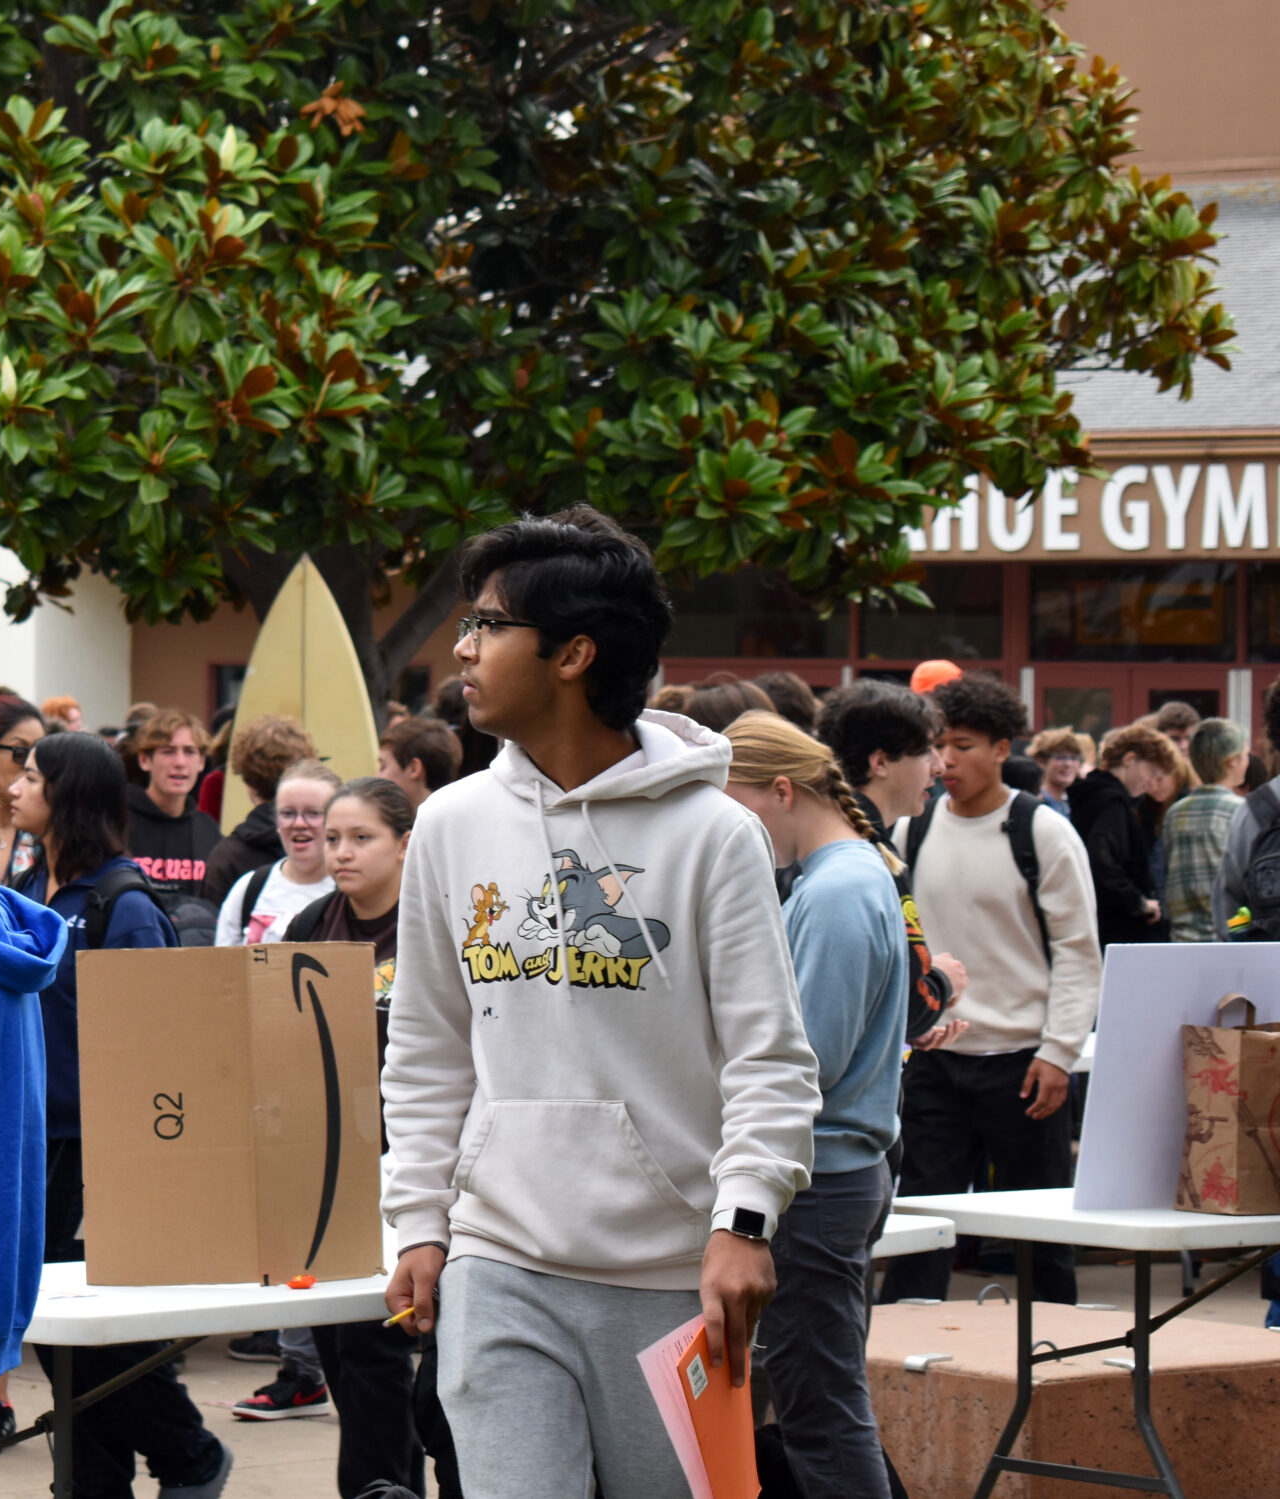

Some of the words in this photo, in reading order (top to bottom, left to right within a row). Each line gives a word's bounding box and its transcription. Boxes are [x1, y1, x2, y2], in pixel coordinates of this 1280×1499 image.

[900, 466, 1080, 551] HUE
[1101, 463, 1280, 551] GYM
[462, 942, 520, 984] TOM
[522, 947, 552, 978] and
[545, 945, 652, 990] JERRY
[153, 1092, 185, 1140] Q2
